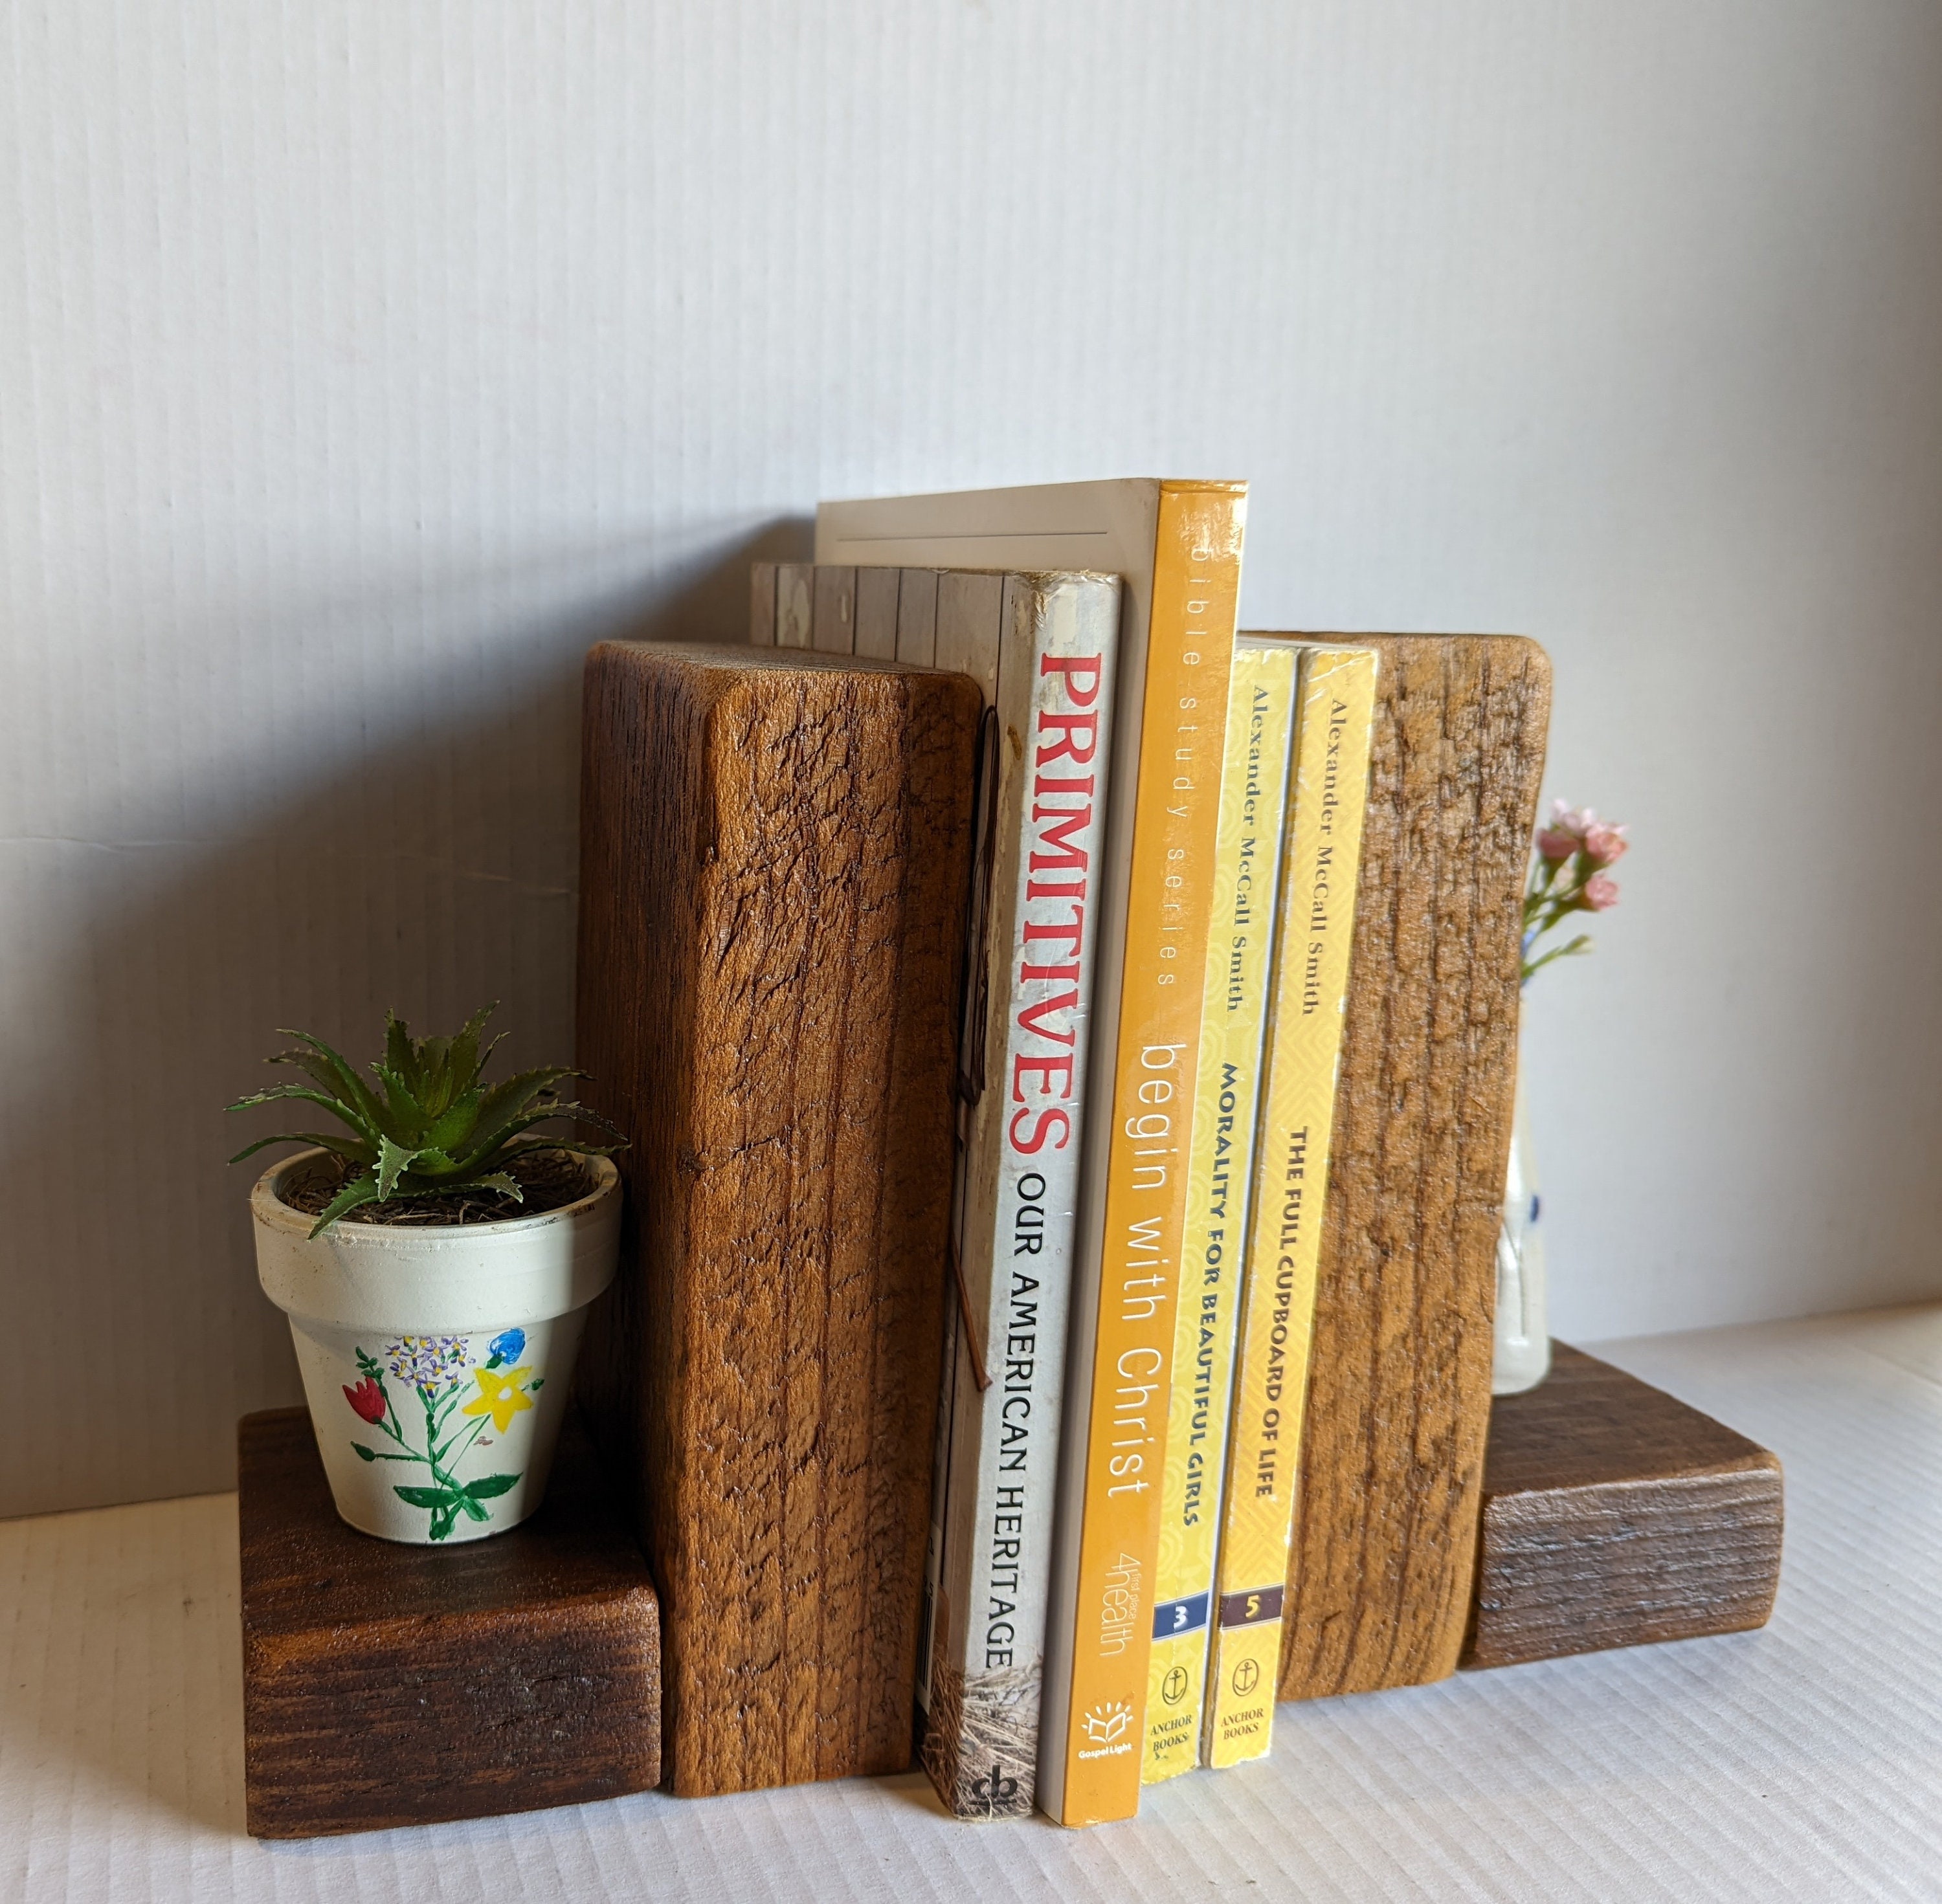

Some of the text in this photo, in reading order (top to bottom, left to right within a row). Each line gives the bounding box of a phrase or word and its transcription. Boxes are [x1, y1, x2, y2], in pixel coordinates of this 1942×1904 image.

[1157, 546, 1213, 986] bible study series
[1227, 684, 1268, 1012] Alexander McCall Smith
[1302, 698, 1347, 1016] Alexander McCall Smith
[986, 652, 1102, 1669] PRIMITIVES OUR AMERICAN HERITAGE
[1108, 1043, 1186, 1499] begin with Christ
[1183, 1063, 1238, 1527] MORALITY FOR BEAUTIFUL GIRLS
[1255, 1126, 1308, 1498] THE FULL CUPBOARD OF LIFE
[1128, 1573, 1141, 1619] first place
[1174, 1606, 1187, 1630] 3
[1245, 1595, 1260, 1617] 5
[1150, 1714, 1192, 1735] ANCHOR
[1221, 1707, 1264, 1727] ANCHOR
[1223, 1722, 1259, 1740] BOOKS
[1078, 1742, 1133, 1759] Gospel Light
[1153, 1732, 1190, 1751] BOOKS
